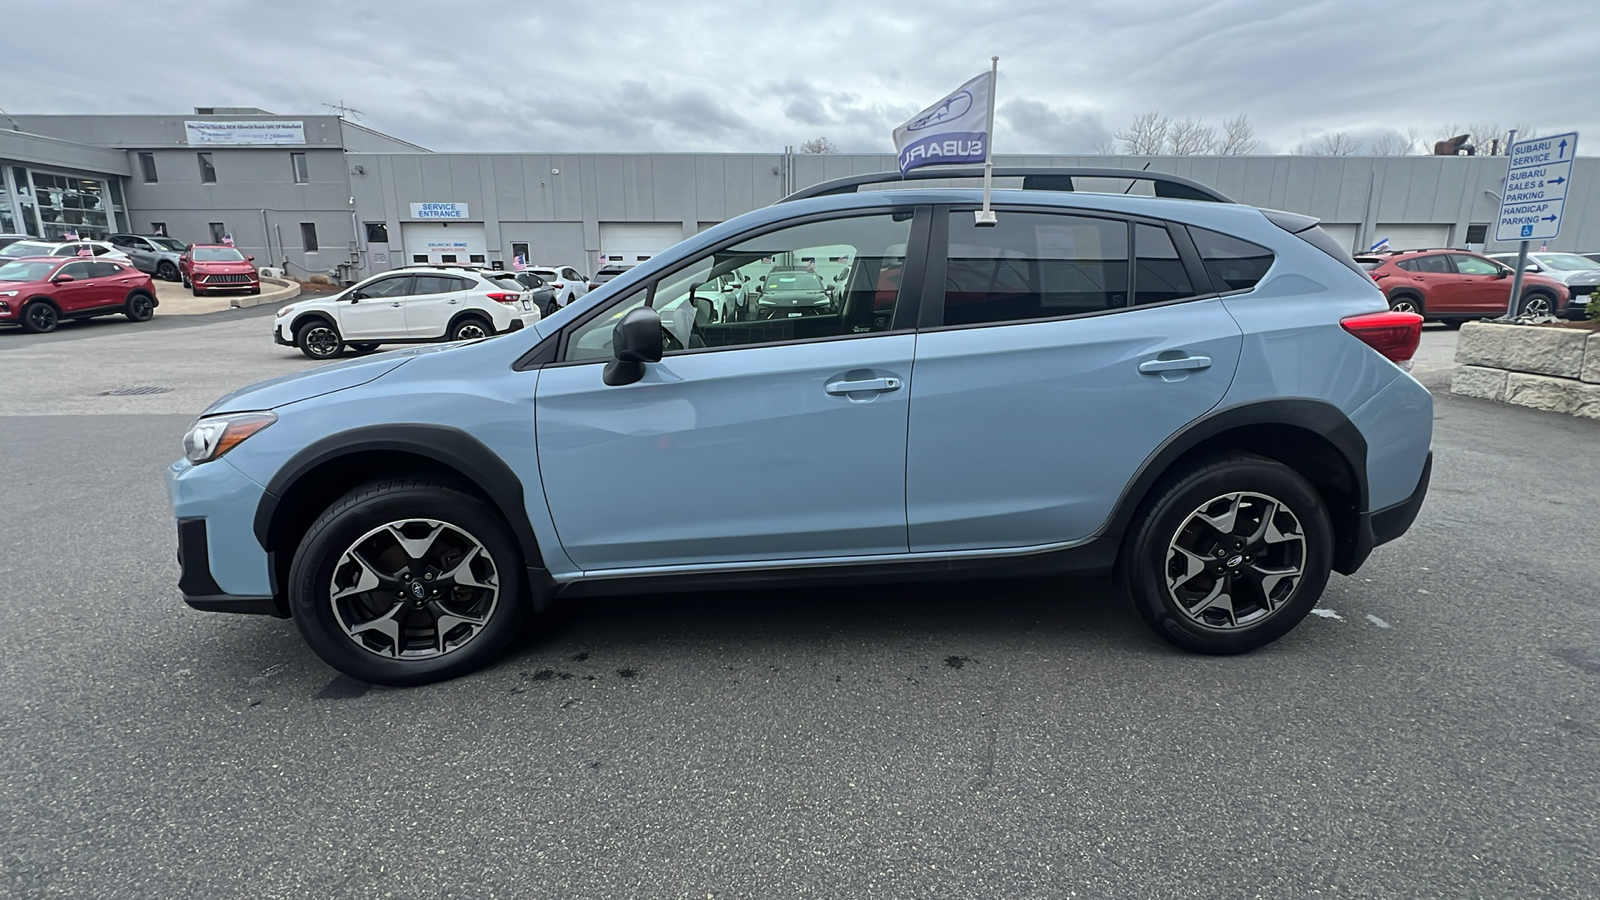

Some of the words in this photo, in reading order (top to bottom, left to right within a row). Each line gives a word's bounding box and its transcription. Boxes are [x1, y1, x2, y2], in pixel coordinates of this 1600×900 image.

[1515, 142, 1551, 155] SUBARU
[1513, 153, 1550, 166] SERVICE
[1510, 169, 1546, 181] SUBARU
[1508, 181, 1535, 191] SALES
[1506, 191, 1544, 202] PARKING
[1504, 204, 1548, 215] HANDICAP
[1501, 216, 1539, 225] PARKING
